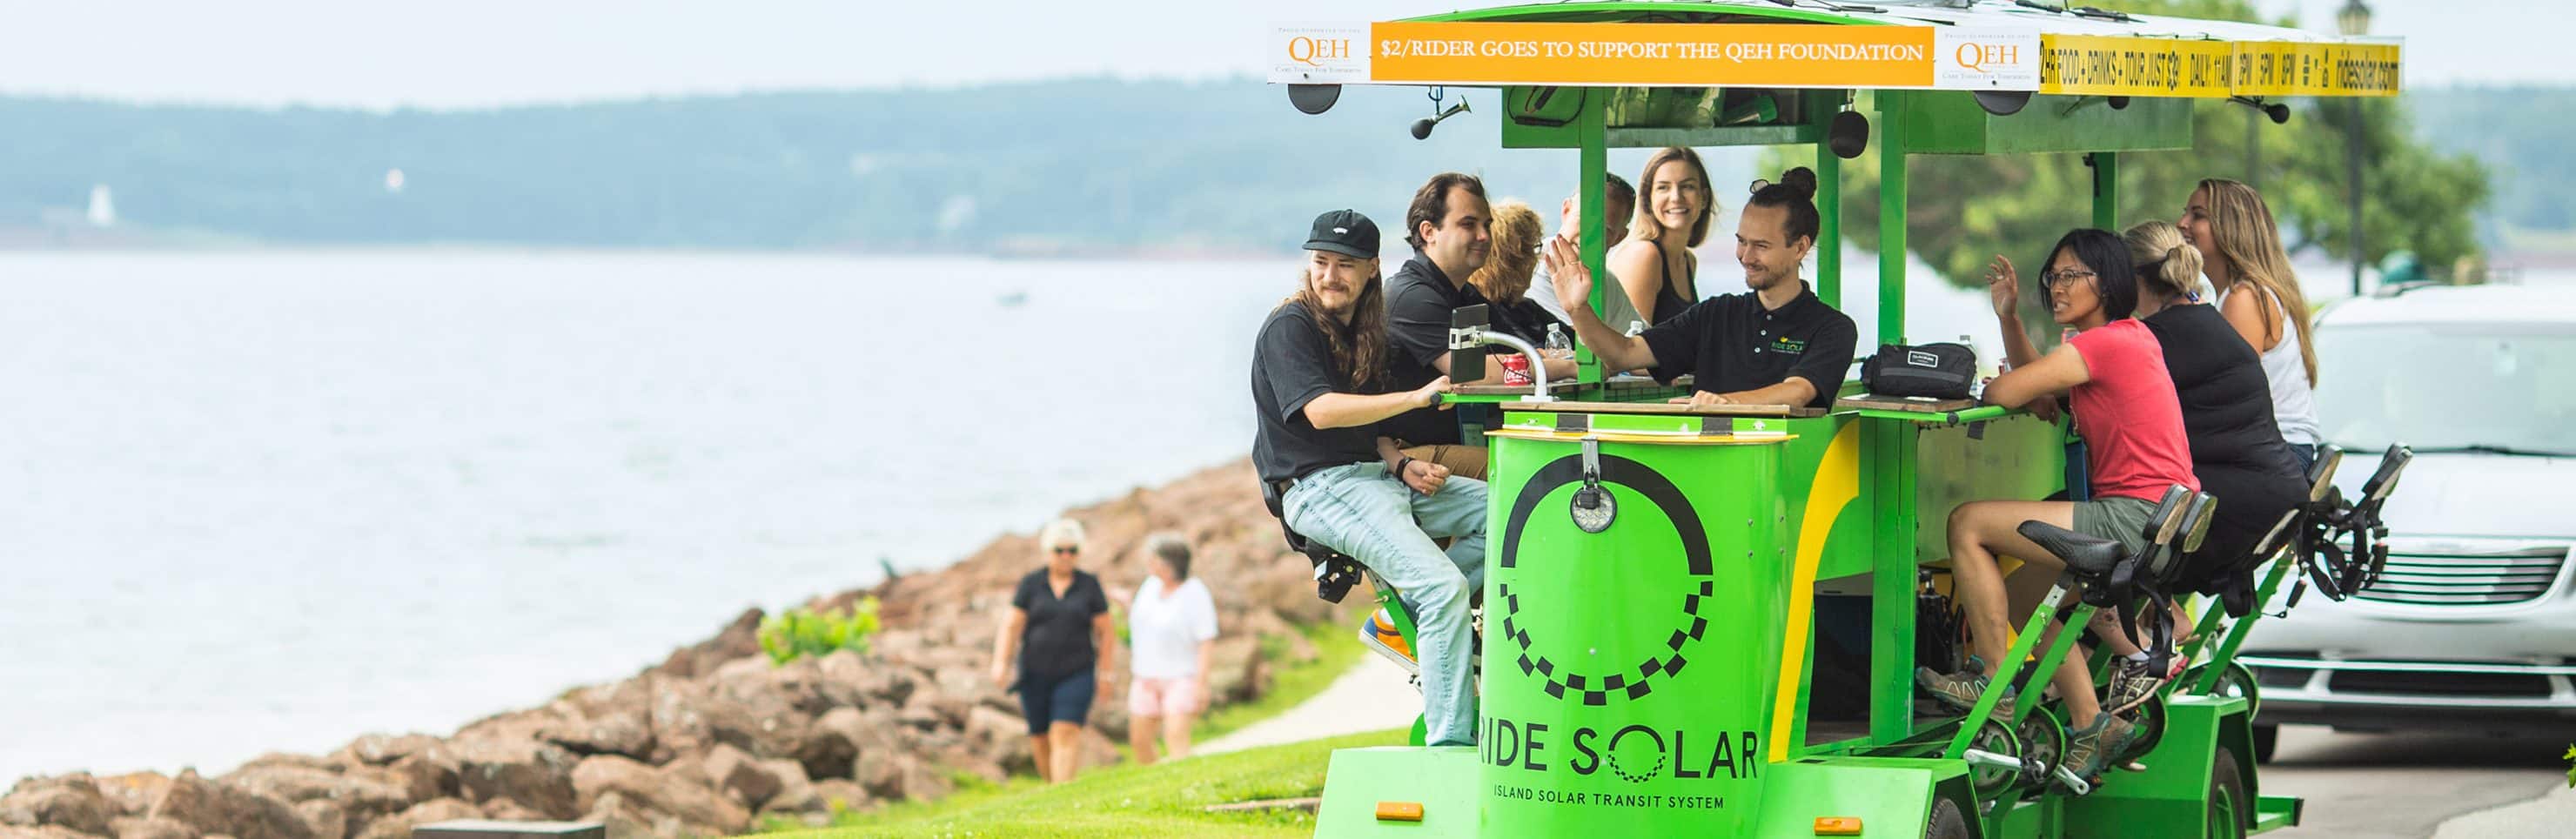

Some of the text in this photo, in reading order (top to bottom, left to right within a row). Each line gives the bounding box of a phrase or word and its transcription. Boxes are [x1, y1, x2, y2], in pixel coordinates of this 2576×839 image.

[1289, 36, 1350, 66] QEH
[1381, 39, 1923, 63] $2/RIDER GOES TO SUPPORT THE QEH FOUNDATION
[1955, 42, 2018, 73] QEH
[2057, 49, 2079, 84] FOOD
[2088, 50, 2116, 85] DRINKS
[2125, 50, 2145, 86] TOUR
[2147, 52, 2166, 87] JUST
[1570, 724, 1758, 783] SOLAR
[1494, 784, 1724, 809] ISLAND SOLAR TRANSIT SYSTEM
